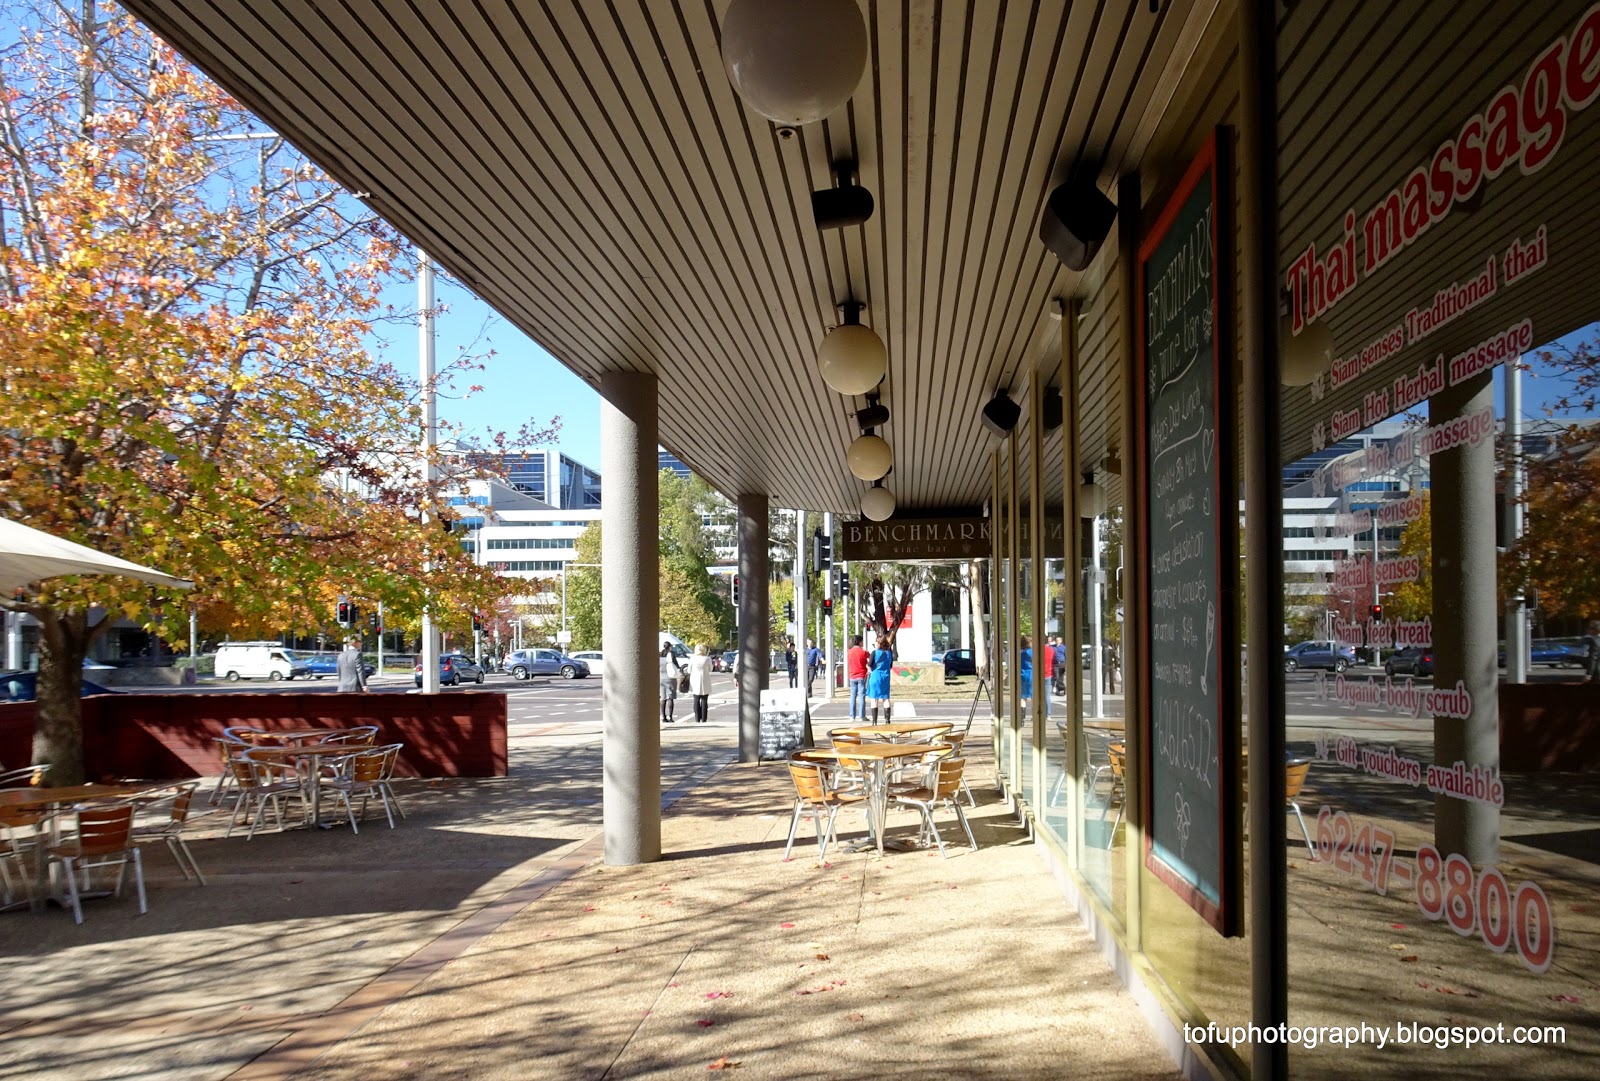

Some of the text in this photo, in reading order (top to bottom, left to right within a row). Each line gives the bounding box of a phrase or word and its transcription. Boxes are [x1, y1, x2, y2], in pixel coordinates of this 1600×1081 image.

[1287, 3, 1600, 337] Thai massage
[1149, 202, 1214, 347] BENCHMARK
[1331, 224, 1548, 390] Siam senses Traditional thai
[1159, 308, 1200, 382] wine bar
[1331, 317, 1533, 441] Siam Hot Herbal massage
[1332, 406, 1494, 491] Siam Hot oil massage
[850, 521, 990, 544] BENCHMARK
[1333, 496, 1423, 539] Aroma senses
[1333, 555, 1419, 588] Facial senses
[1334, 616, 1432, 648] Siam feet treat
[1335, 674, 1471, 719] Organic body scrub
[1336, 736, 1504, 810] Gift vouchers available
[1316, 804, 1554, 976] 6247-8800
